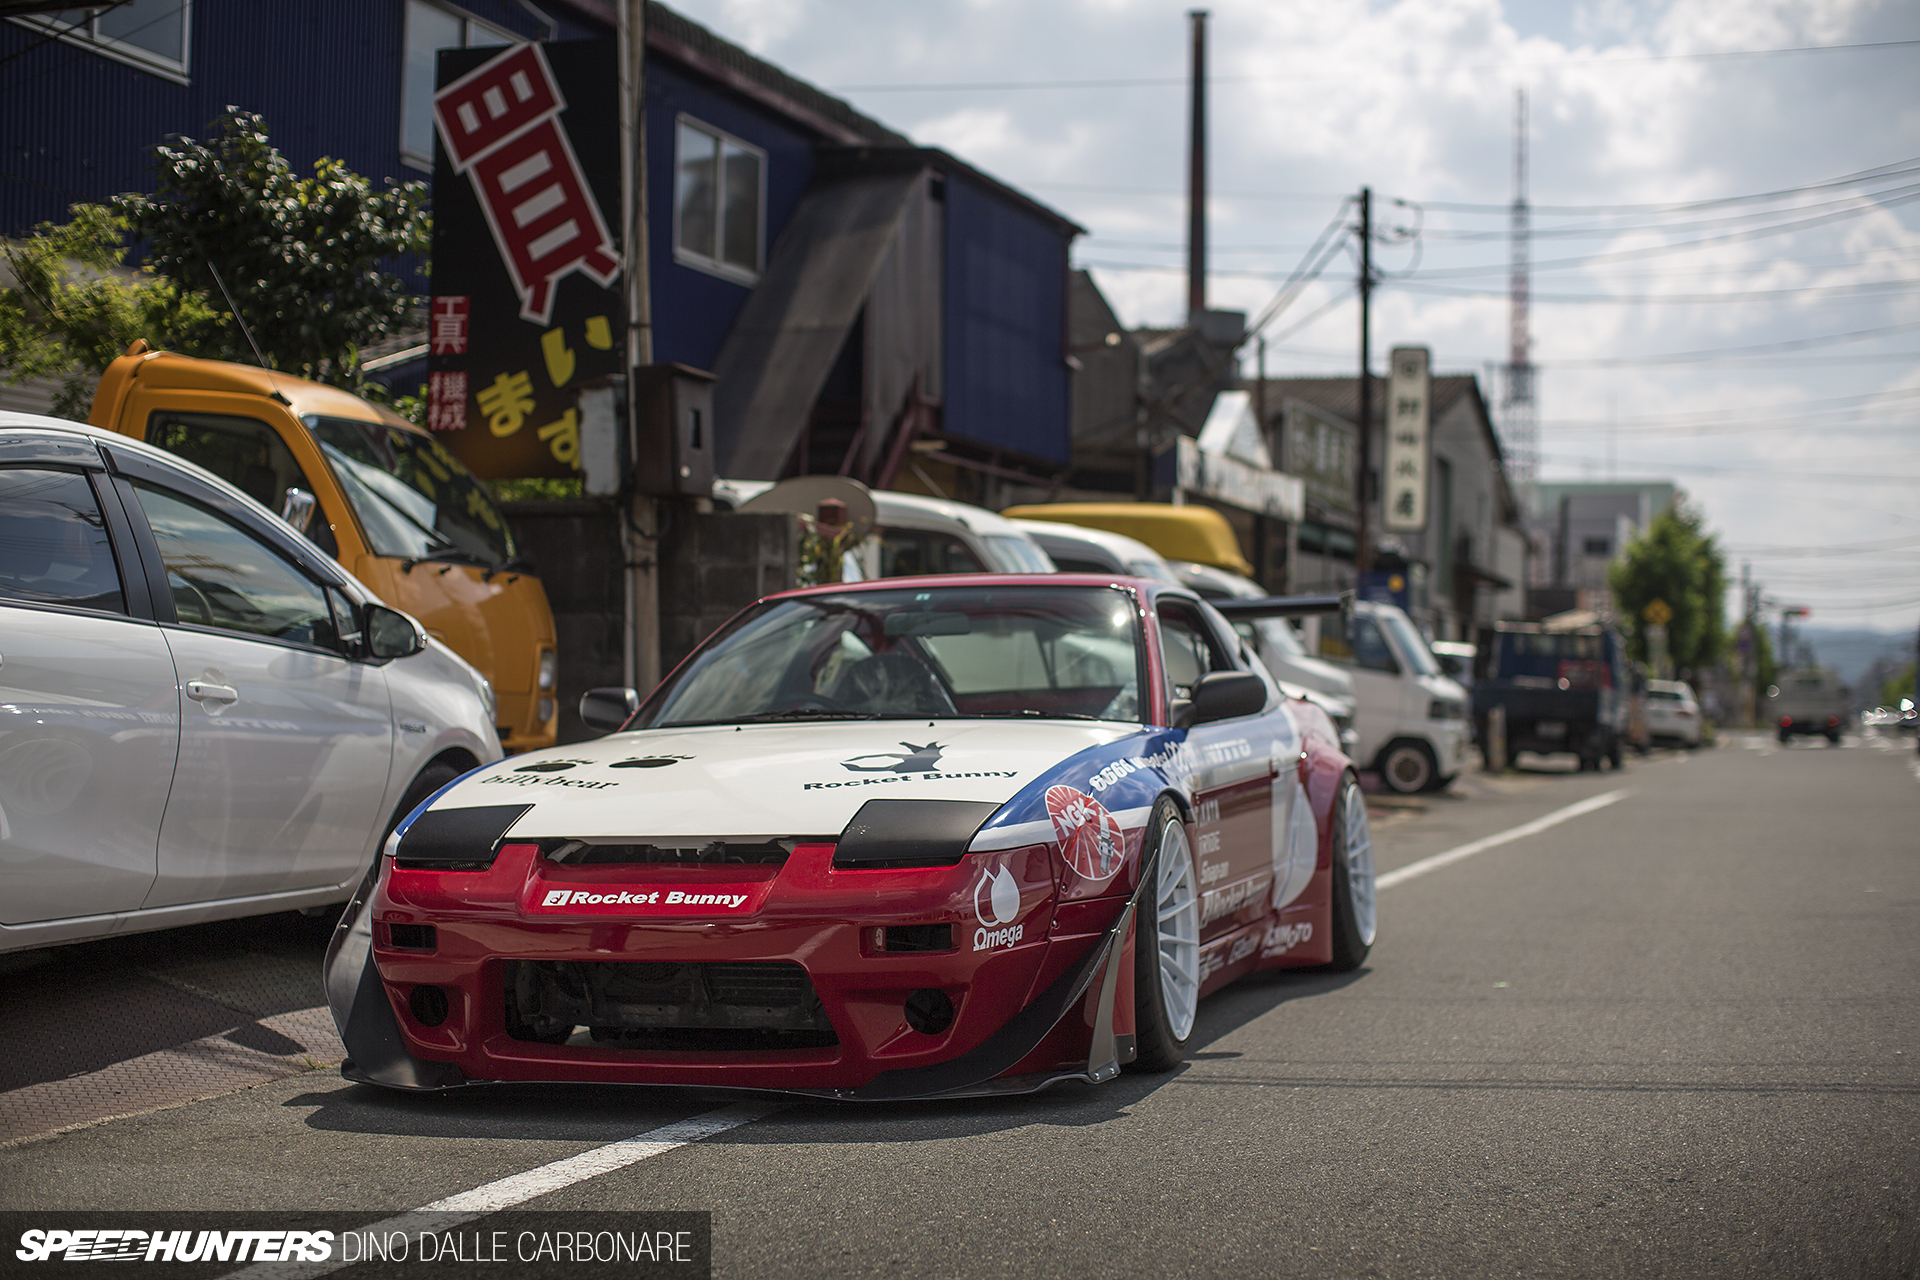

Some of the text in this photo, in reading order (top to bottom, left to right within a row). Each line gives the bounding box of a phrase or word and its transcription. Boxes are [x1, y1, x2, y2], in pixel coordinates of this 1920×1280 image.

[434, 41, 625, 327] 買
[427, 295, 470, 431] 工具 機械
[803, 770, 1018, 790] Rocket Bunny
[1054, 797, 1097, 837] NGK
[569, 890, 749, 908] Rocket Bunny
